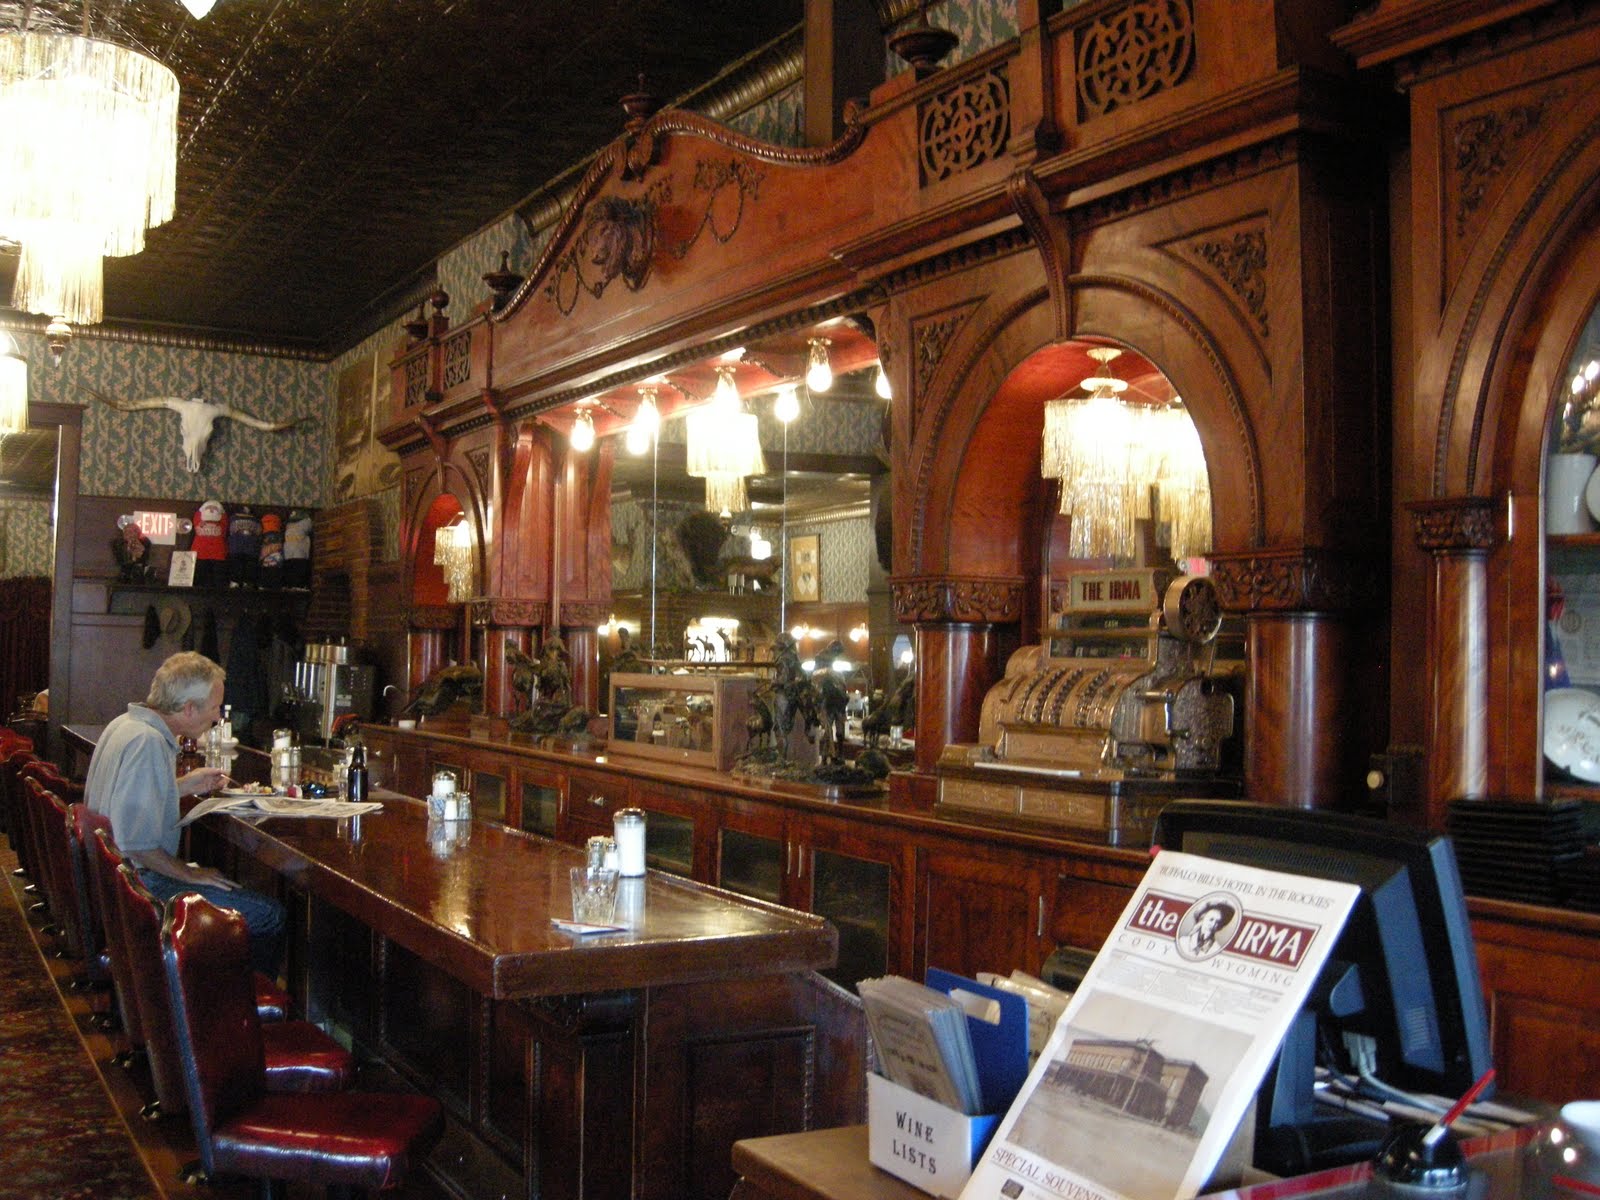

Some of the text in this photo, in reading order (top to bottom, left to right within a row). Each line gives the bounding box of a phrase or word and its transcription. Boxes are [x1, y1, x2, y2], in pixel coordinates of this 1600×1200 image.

[141, 513, 170, 534] EXIT
[1081, 580, 1141, 601] THE IRMA
[1222, 878, 1255, 895] HOTEL
[1255, 884, 1267, 896] IN
[1268, 887, 1289, 901] THE
[1138, 900, 1303, 962] the IRMA
[1117, 933, 1296, 987] CODY WYOMING
[895, 1112, 934, 1144] WINE
[892, 1139, 937, 1175] LISTS
[992, 1147, 1108, 1200] SPECIAL SOUVEN
